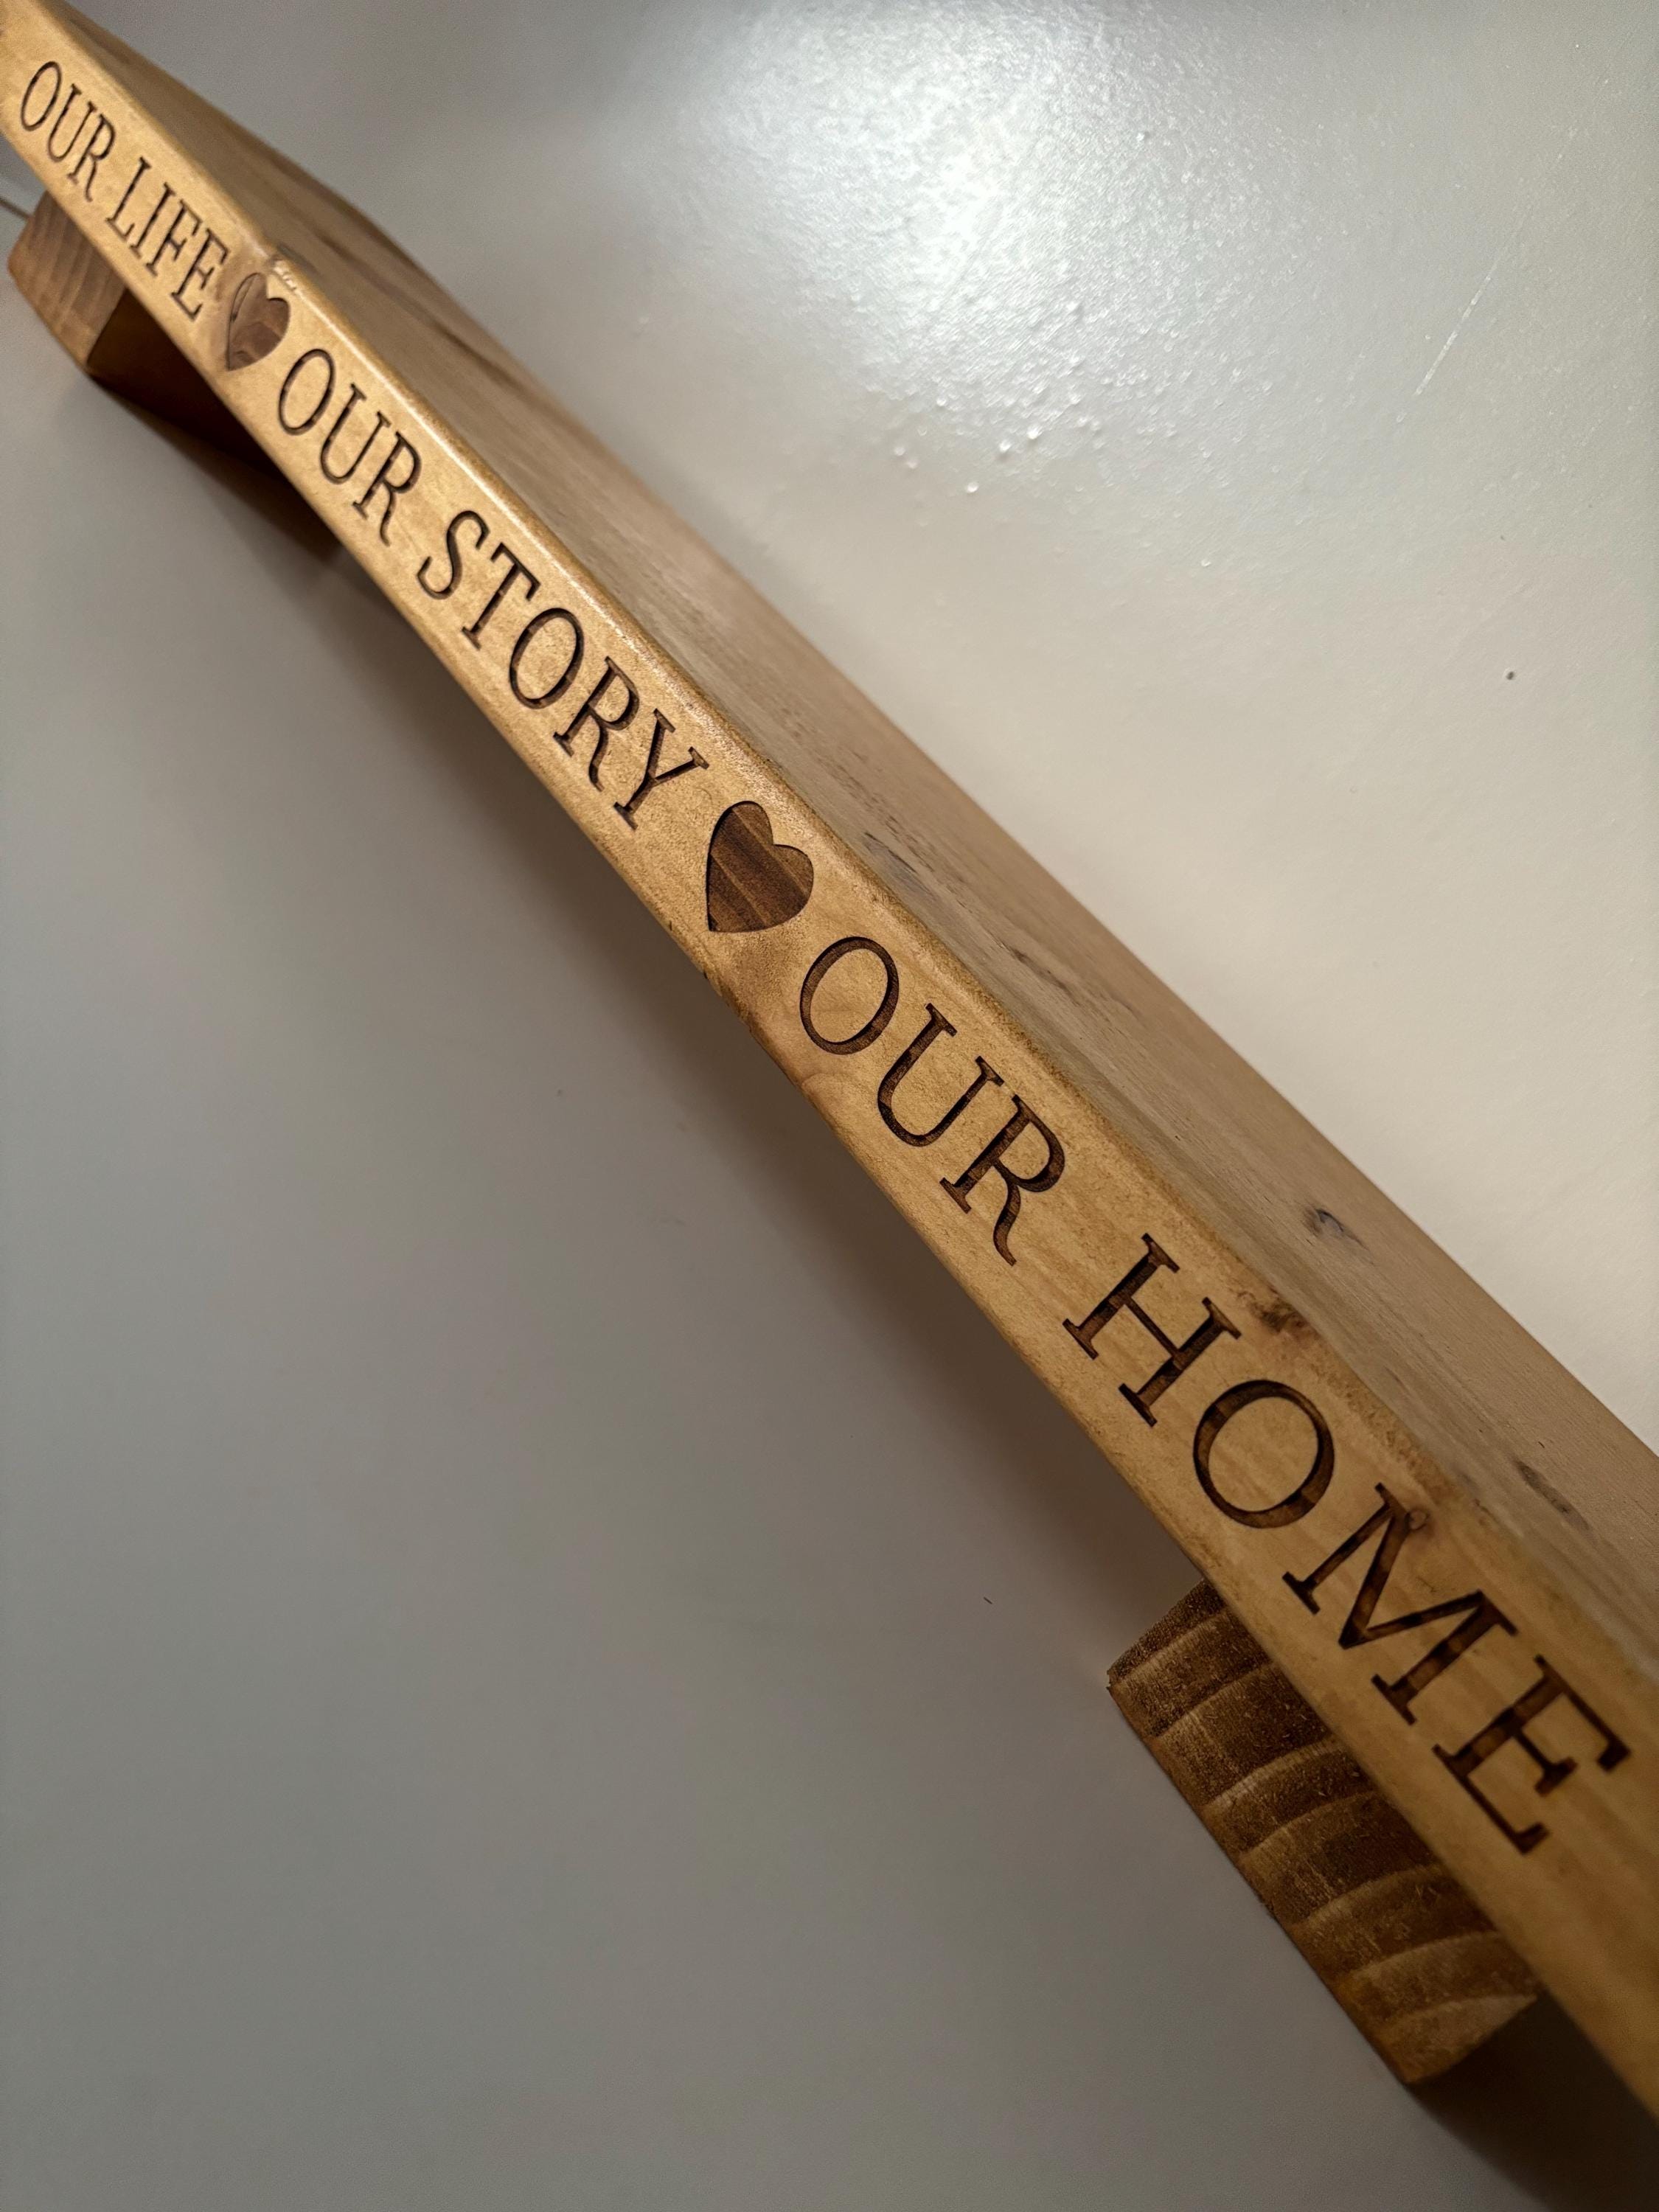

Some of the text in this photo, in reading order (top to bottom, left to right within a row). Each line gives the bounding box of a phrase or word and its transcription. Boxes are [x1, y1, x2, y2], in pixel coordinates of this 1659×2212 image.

[20, 61, 1632, 1854] OUR LIFE OUR STORY OUR HOME
